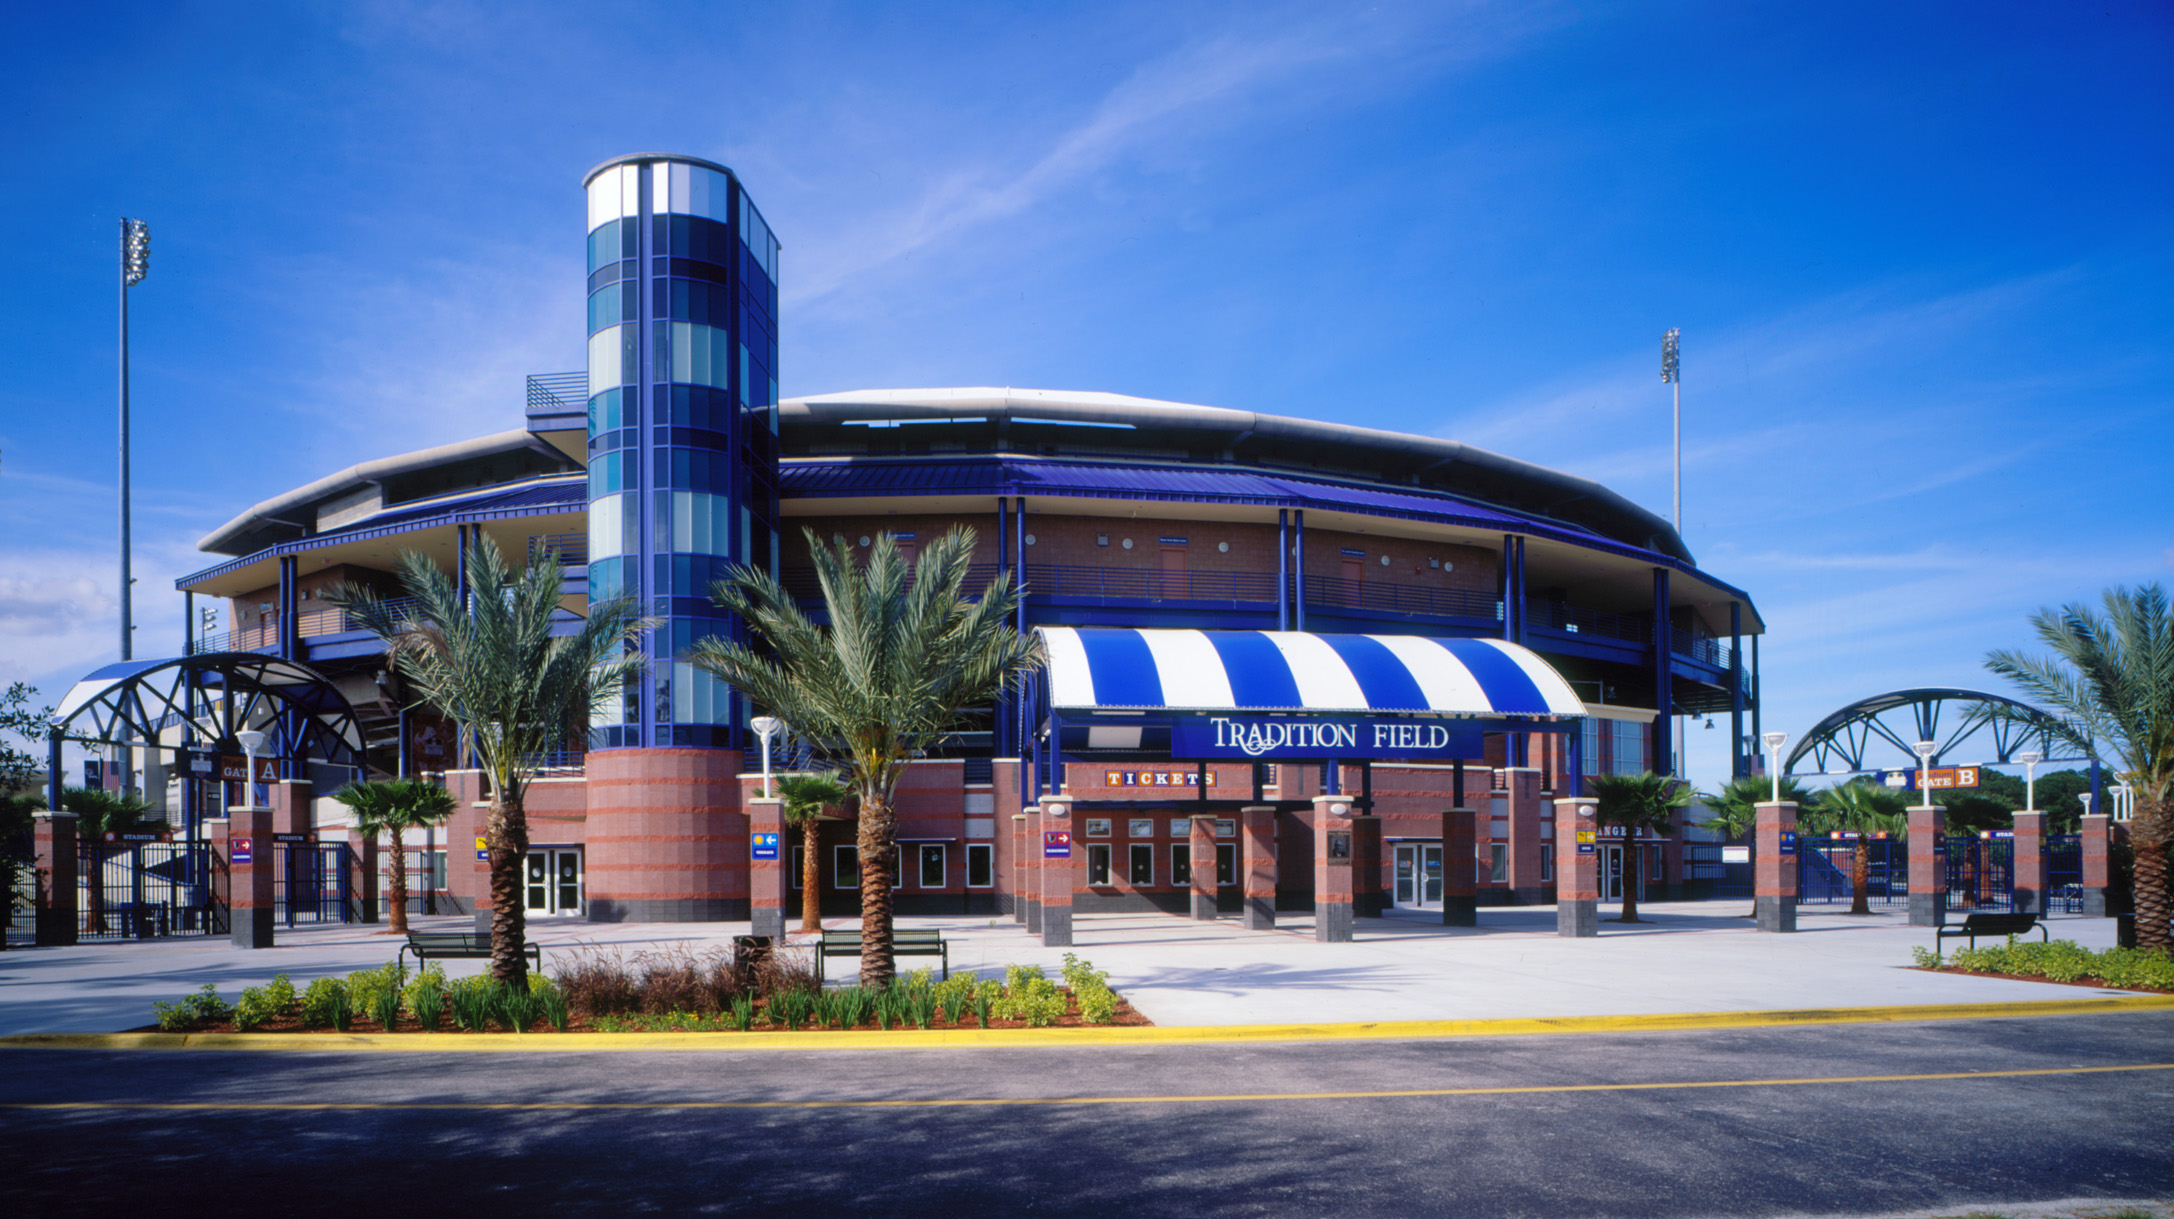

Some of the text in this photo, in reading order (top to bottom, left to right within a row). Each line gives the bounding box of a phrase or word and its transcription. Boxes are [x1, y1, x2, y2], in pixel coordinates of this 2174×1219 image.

[1210, 717, 1449, 756] TRADITION FIELD
[223, 762, 277, 780] GAT A
[1108, 773, 1214, 785] TICKETS
[1917, 771, 1952, 779] Sadium
[1957, 769, 1975, 786] B
